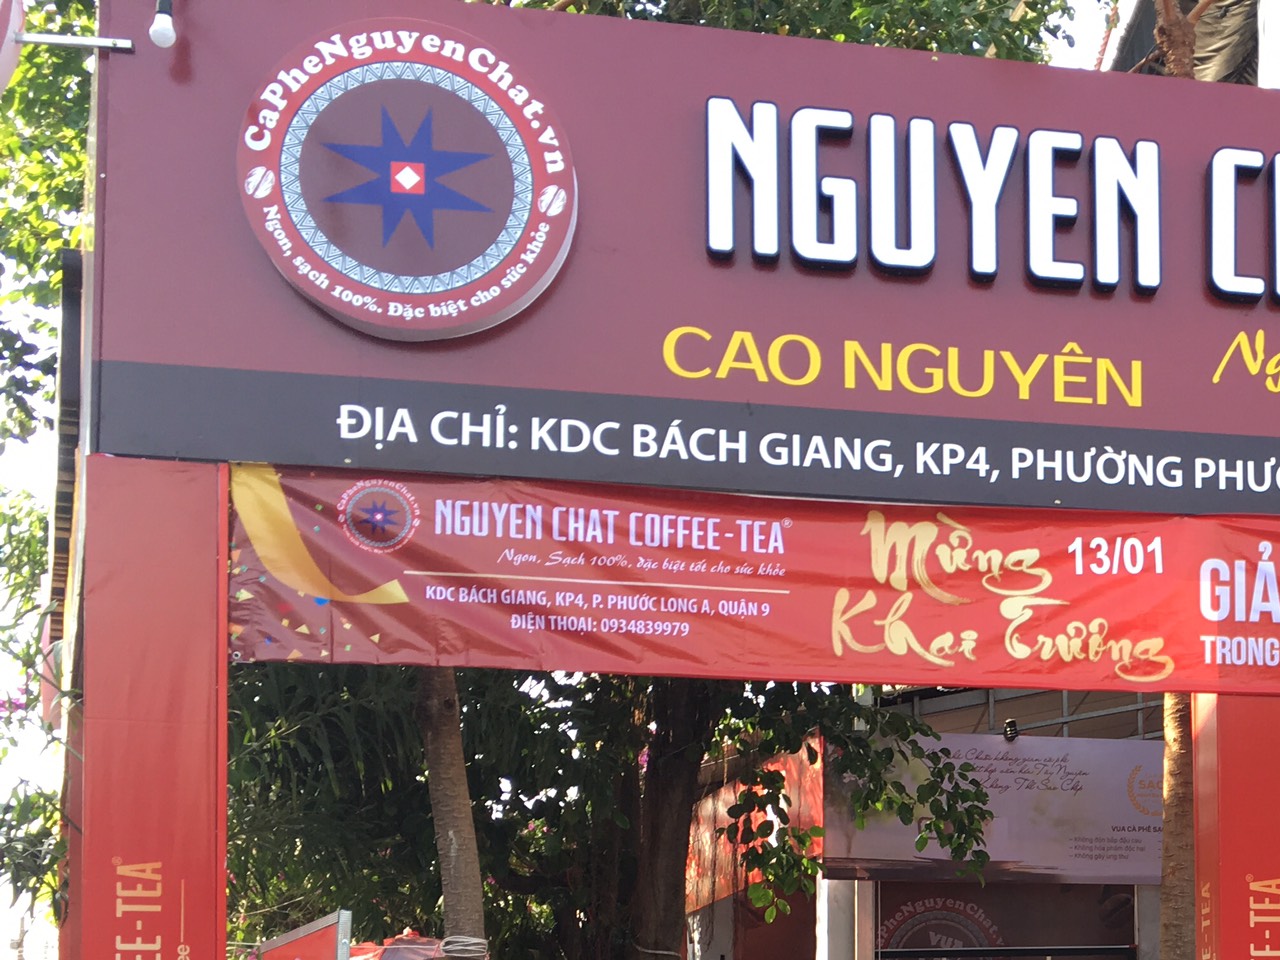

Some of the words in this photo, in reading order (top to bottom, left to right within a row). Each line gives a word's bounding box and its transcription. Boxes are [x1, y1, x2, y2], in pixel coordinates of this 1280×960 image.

[244, 30, 566, 174] CaPheNguyenChat.vn
[706, 97, 1161, 290] NGUYEN
[263, 205, 292, 257] Ngon,
[293, 255, 330, 290] sạch
[388, 301, 425, 320] Đặc
[428, 300, 468, 317] biệt
[470, 284, 501, 307] cho
[500, 262, 527, 289] sức
[521, 222, 550, 271] khỏe
[662, 326, 821, 387] CAO
[845, 339, 1143, 407] NGUYÊN
[336, 404, 418, 450] ĐỊA
[430, 404, 519, 449] CHỈ:
[530, 417, 620, 455] KDC
[632, 419, 747, 463] BÁCH
[758, 432, 904, 478] GIANG,
[915, 441, 1000, 483] KP4,
[1011, 446, 1184, 489] PHƯỜNG
[435, 499, 543, 540] NGUYEN
[552, 506, 620, 544] CHAT
[860, 509, 1054, 605] Mừng
[1067, 535, 1165, 577] 13/01
[425, 586, 455, 601] KDC
[458, 585, 497, 603] BÁCH
[501, 589, 551, 608] GIANG,
[555, 592, 588, 609] KP4,
[592, 594, 604, 608] P.
[607, 593, 657, 611] PHƯỚC
[660, 597, 698, 613] LONG
[700, 600, 715, 616] A,
[718, 598, 757, 619] QUẬN
[761, 603, 770, 616] 9
[496, 548, 541, 566] Ngon,
[544, 551, 585, 567] Sạch
[590, 554, 632, 570] 100%,
[636, 556, 659, 571] đặc
[662, 558, 686, 573] biệt
[689, 559, 707, 573] tốt
[710, 561, 731, 574] cho
[734, 562, 753, 575] sức
[757, 563, 786, 577] khỏe
[510, 612, 545, 633] ĐIỆN
[548, 615, 597, 635] THOẠI:
[601, 618, 689, 636] 0934839979
[831, 587, 979, 667] Khai
[1200, 634, 1280, 668] TRONG
[876, 897, 1006, 947] aPheNguyenChat.v
